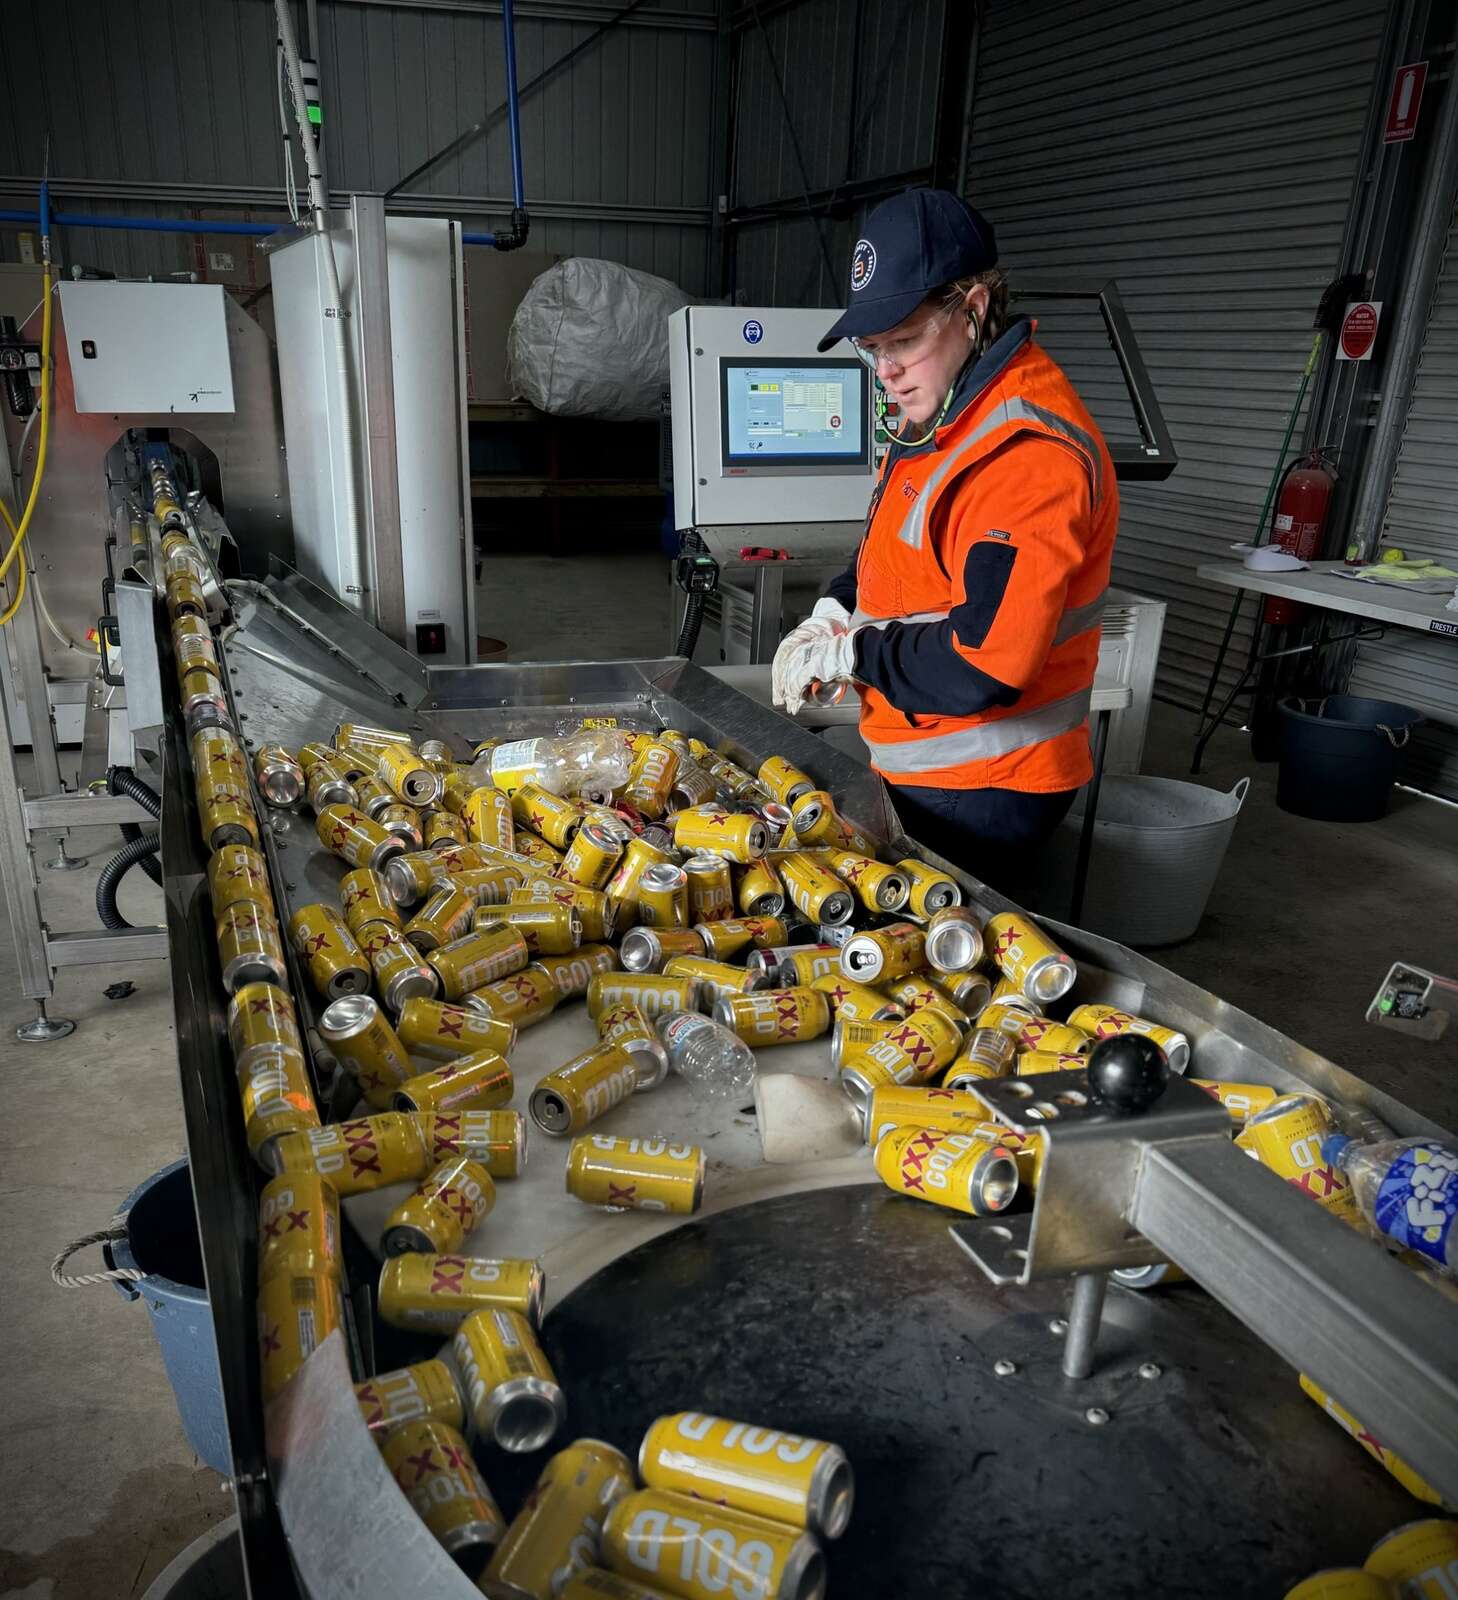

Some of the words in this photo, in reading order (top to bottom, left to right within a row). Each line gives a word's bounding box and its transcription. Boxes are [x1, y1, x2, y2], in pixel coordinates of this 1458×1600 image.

[1431, 621, 1457, 634] TRESTLE
[752, 991, 775, 1033] OLD
[250, 1055, 292, 1119] GOLD
[866, 1040, 915, 1085] GOLD
[341, 1118, 382, 1180] XXX
[902, 1131, 950, 1194] XXX
[925, 1135, 974, 1189] GOLD
[627, 1509, 775, 1600] GOLD
